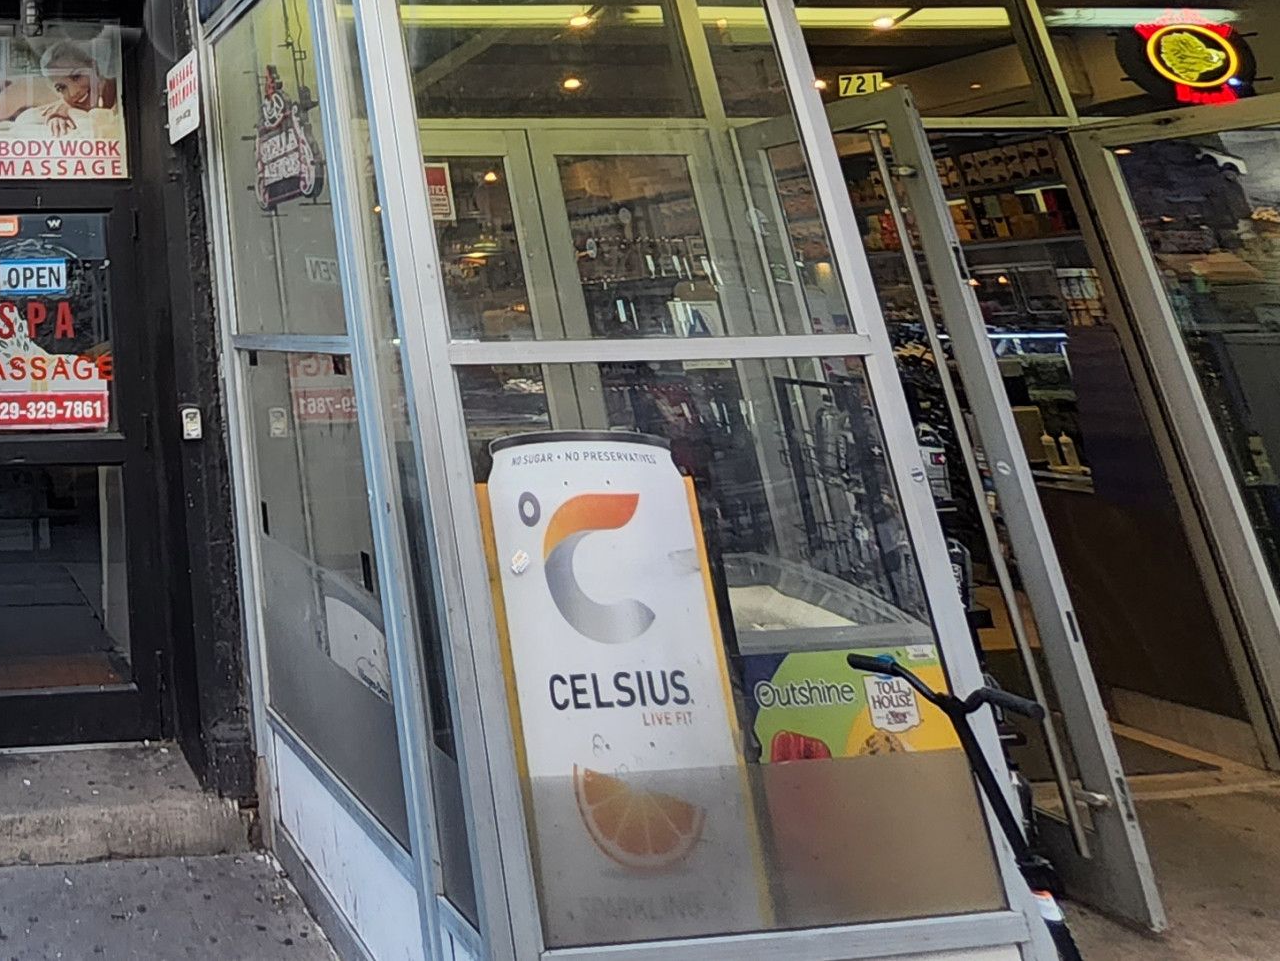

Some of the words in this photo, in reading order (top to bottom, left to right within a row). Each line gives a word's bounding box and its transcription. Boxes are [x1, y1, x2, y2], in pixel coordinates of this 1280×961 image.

[840, 75, 879, 94] 721
[59, 140, 121, 157] WORK
[7, 266, 61, 289] OPEN
[511, 455, 521, 466] NO
[524, 453, 554, 465] SUGAR
[565, 451, 580, 462] NO
[583, 451, 658, 465] PRESERVATIVES
[549, 669, 692, 711] CELSIUS
[755, 679, 855, 709] Outshine
[871, 694, 914, 710] HOUSE
[642, 712, 673, 727] LIVE
[676, 711, 694, 726] FIT
